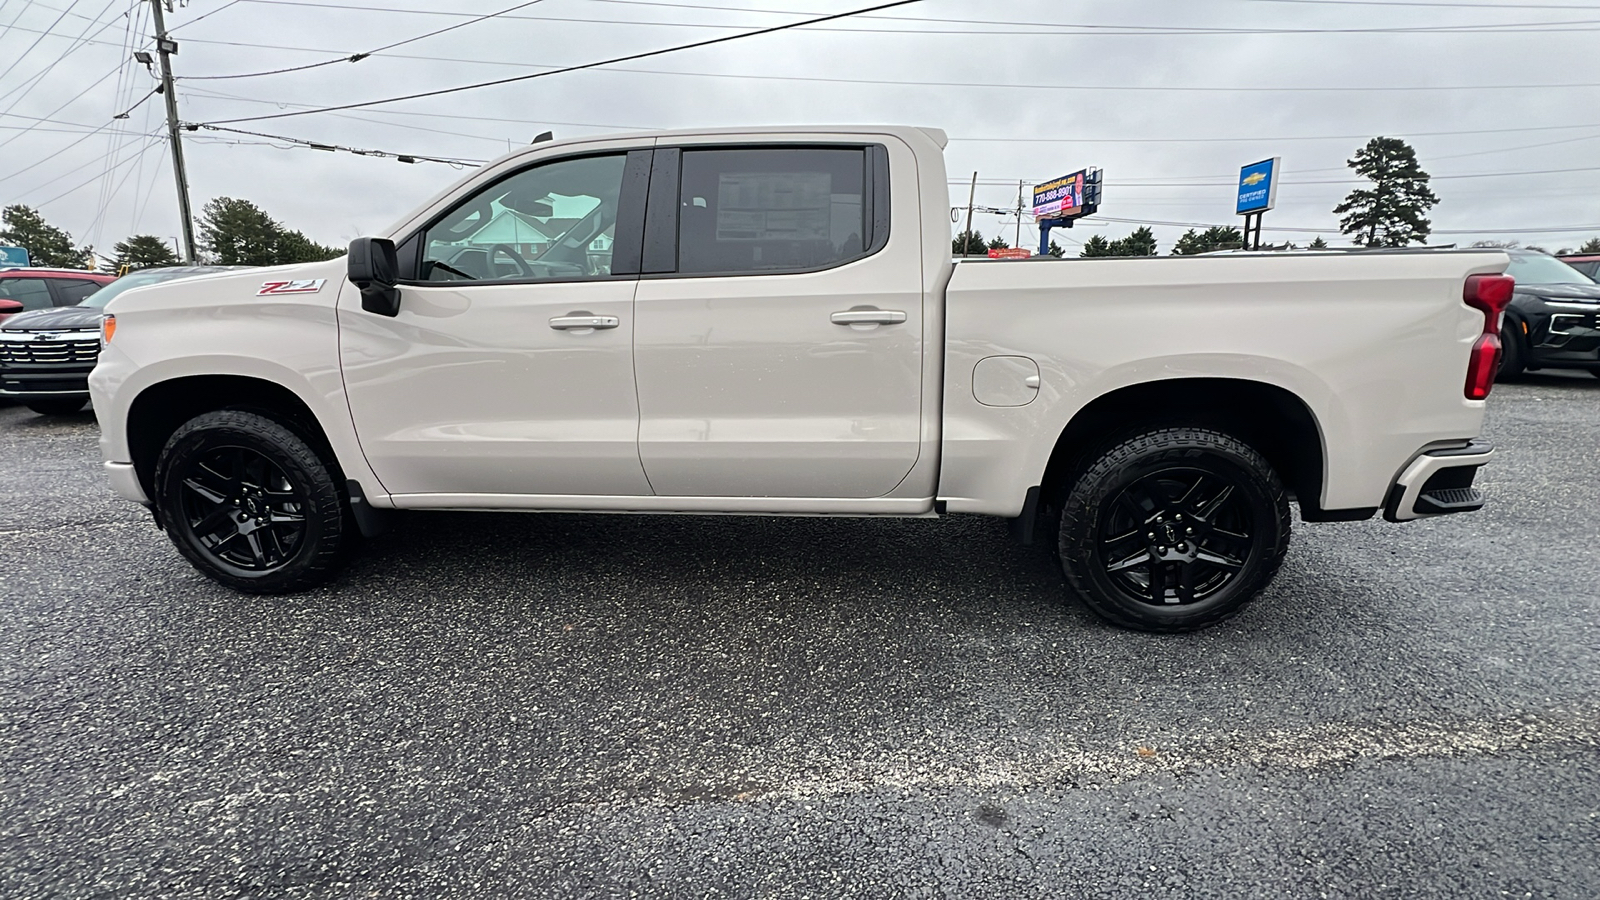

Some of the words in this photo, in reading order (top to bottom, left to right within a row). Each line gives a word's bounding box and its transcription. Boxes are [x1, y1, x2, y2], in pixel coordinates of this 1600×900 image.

[1035, 185, 1073, 204] 770-888-8901
[1239, 189, 1267, 200] CERTIFIED
[256, 279, 328, 296] Z71
